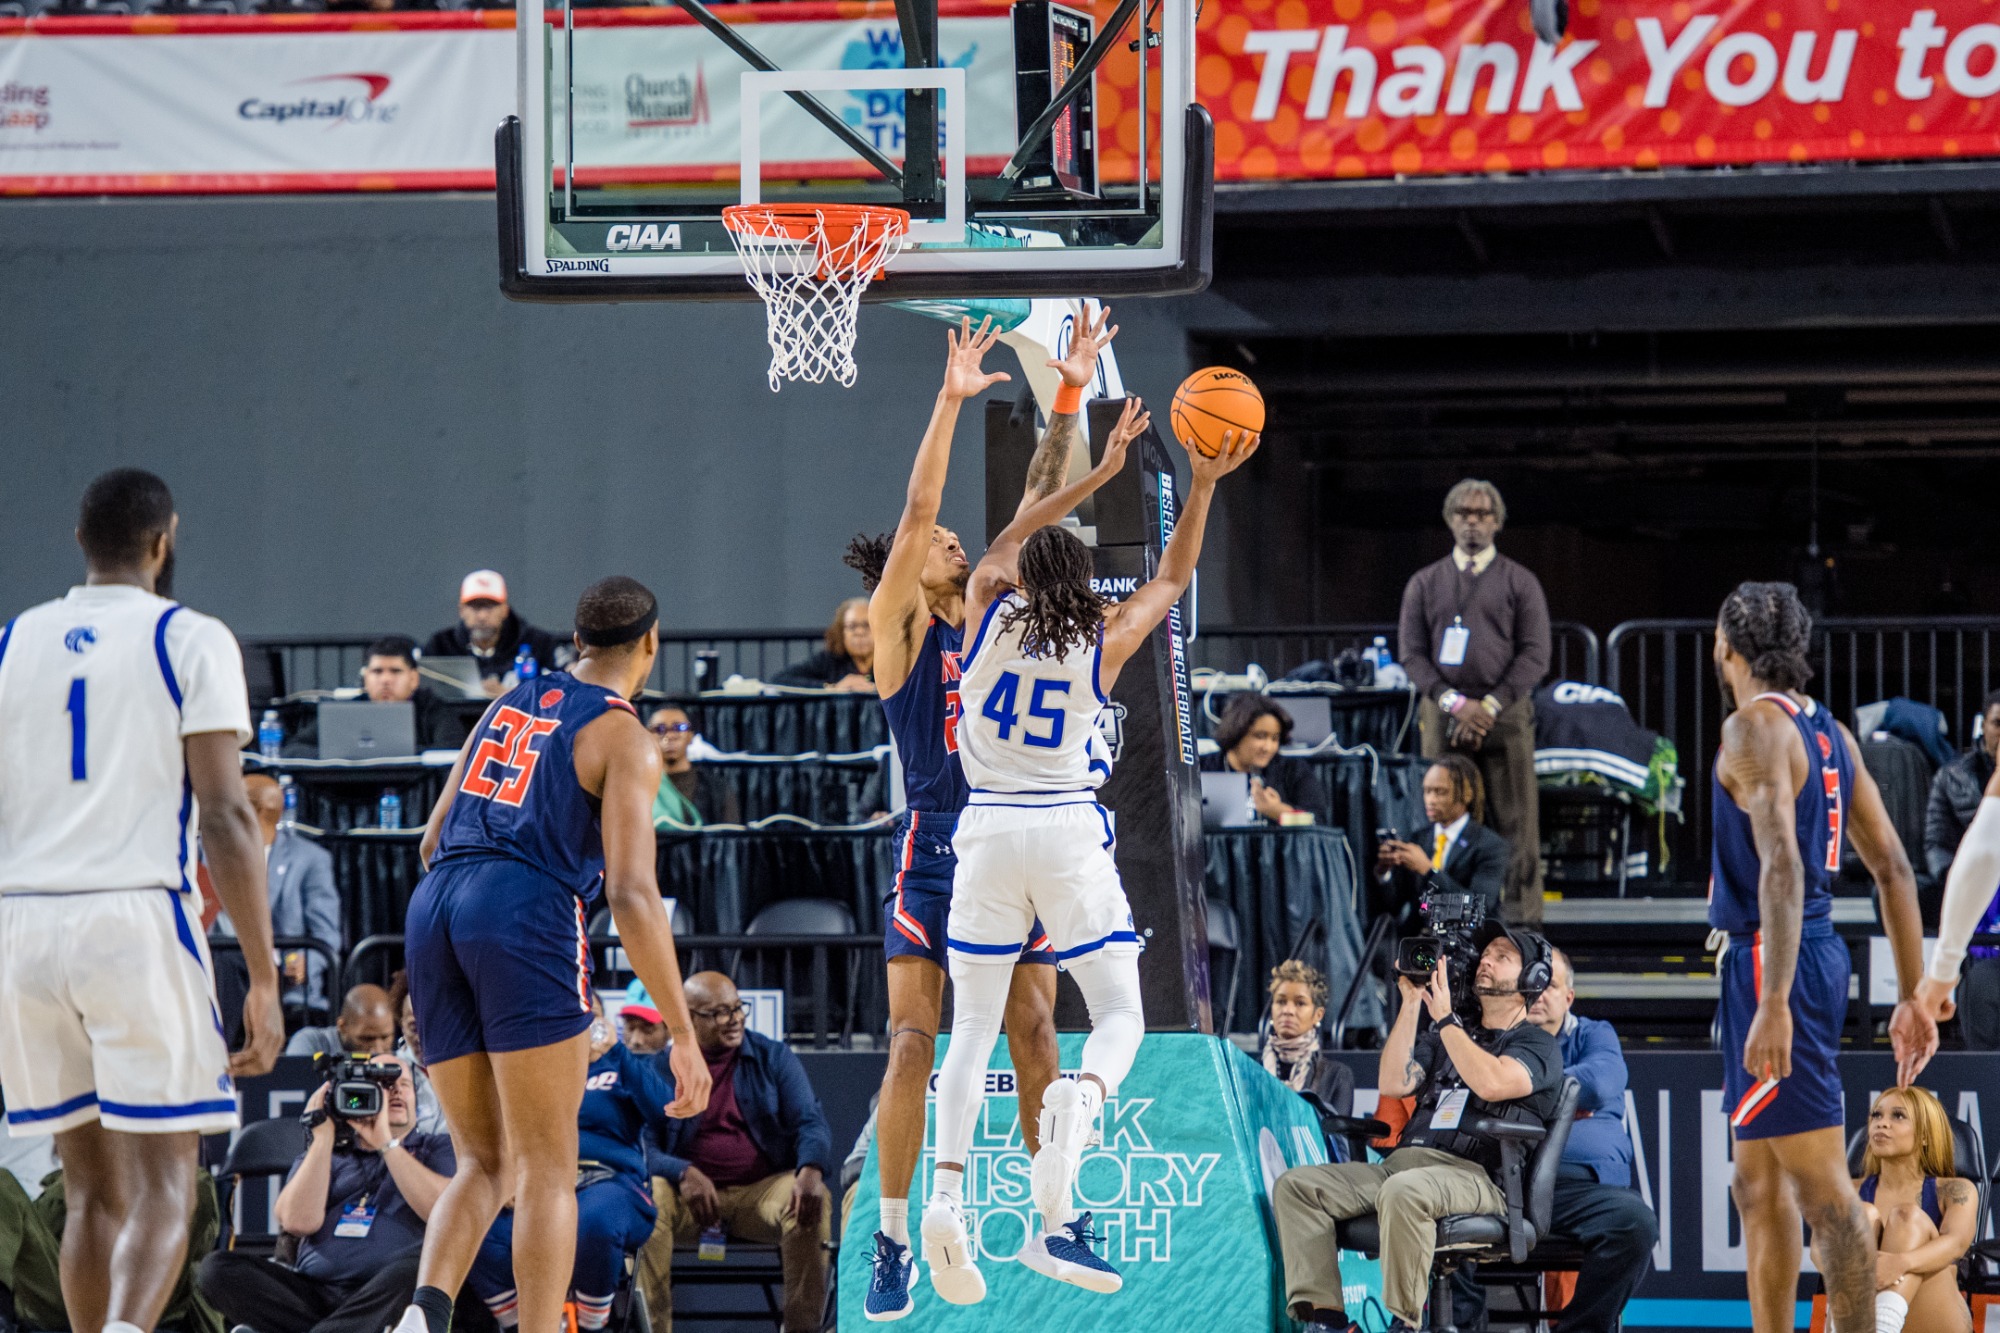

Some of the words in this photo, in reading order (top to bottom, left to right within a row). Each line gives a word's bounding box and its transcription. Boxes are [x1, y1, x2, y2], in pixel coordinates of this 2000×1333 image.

[1242, 26, 1598, 121] Thank
[1636, 14, 1858, 111] You
[1895, 9, 2000, 98] to
[866, 121, 946, 149] THS
[606, 223, 682, 250] CIAA
[546, 258, 610, 273] SPALDING
[1090, 577, 1137, 593] BANK
[980, 669, 1071, 749] 45
[1553, 681, 1626, 708] CIA
[64, 676, 87, 782] 1
[459, 704, 562, 808] 25
[922, 1151, 1221, 1206] HISORY
